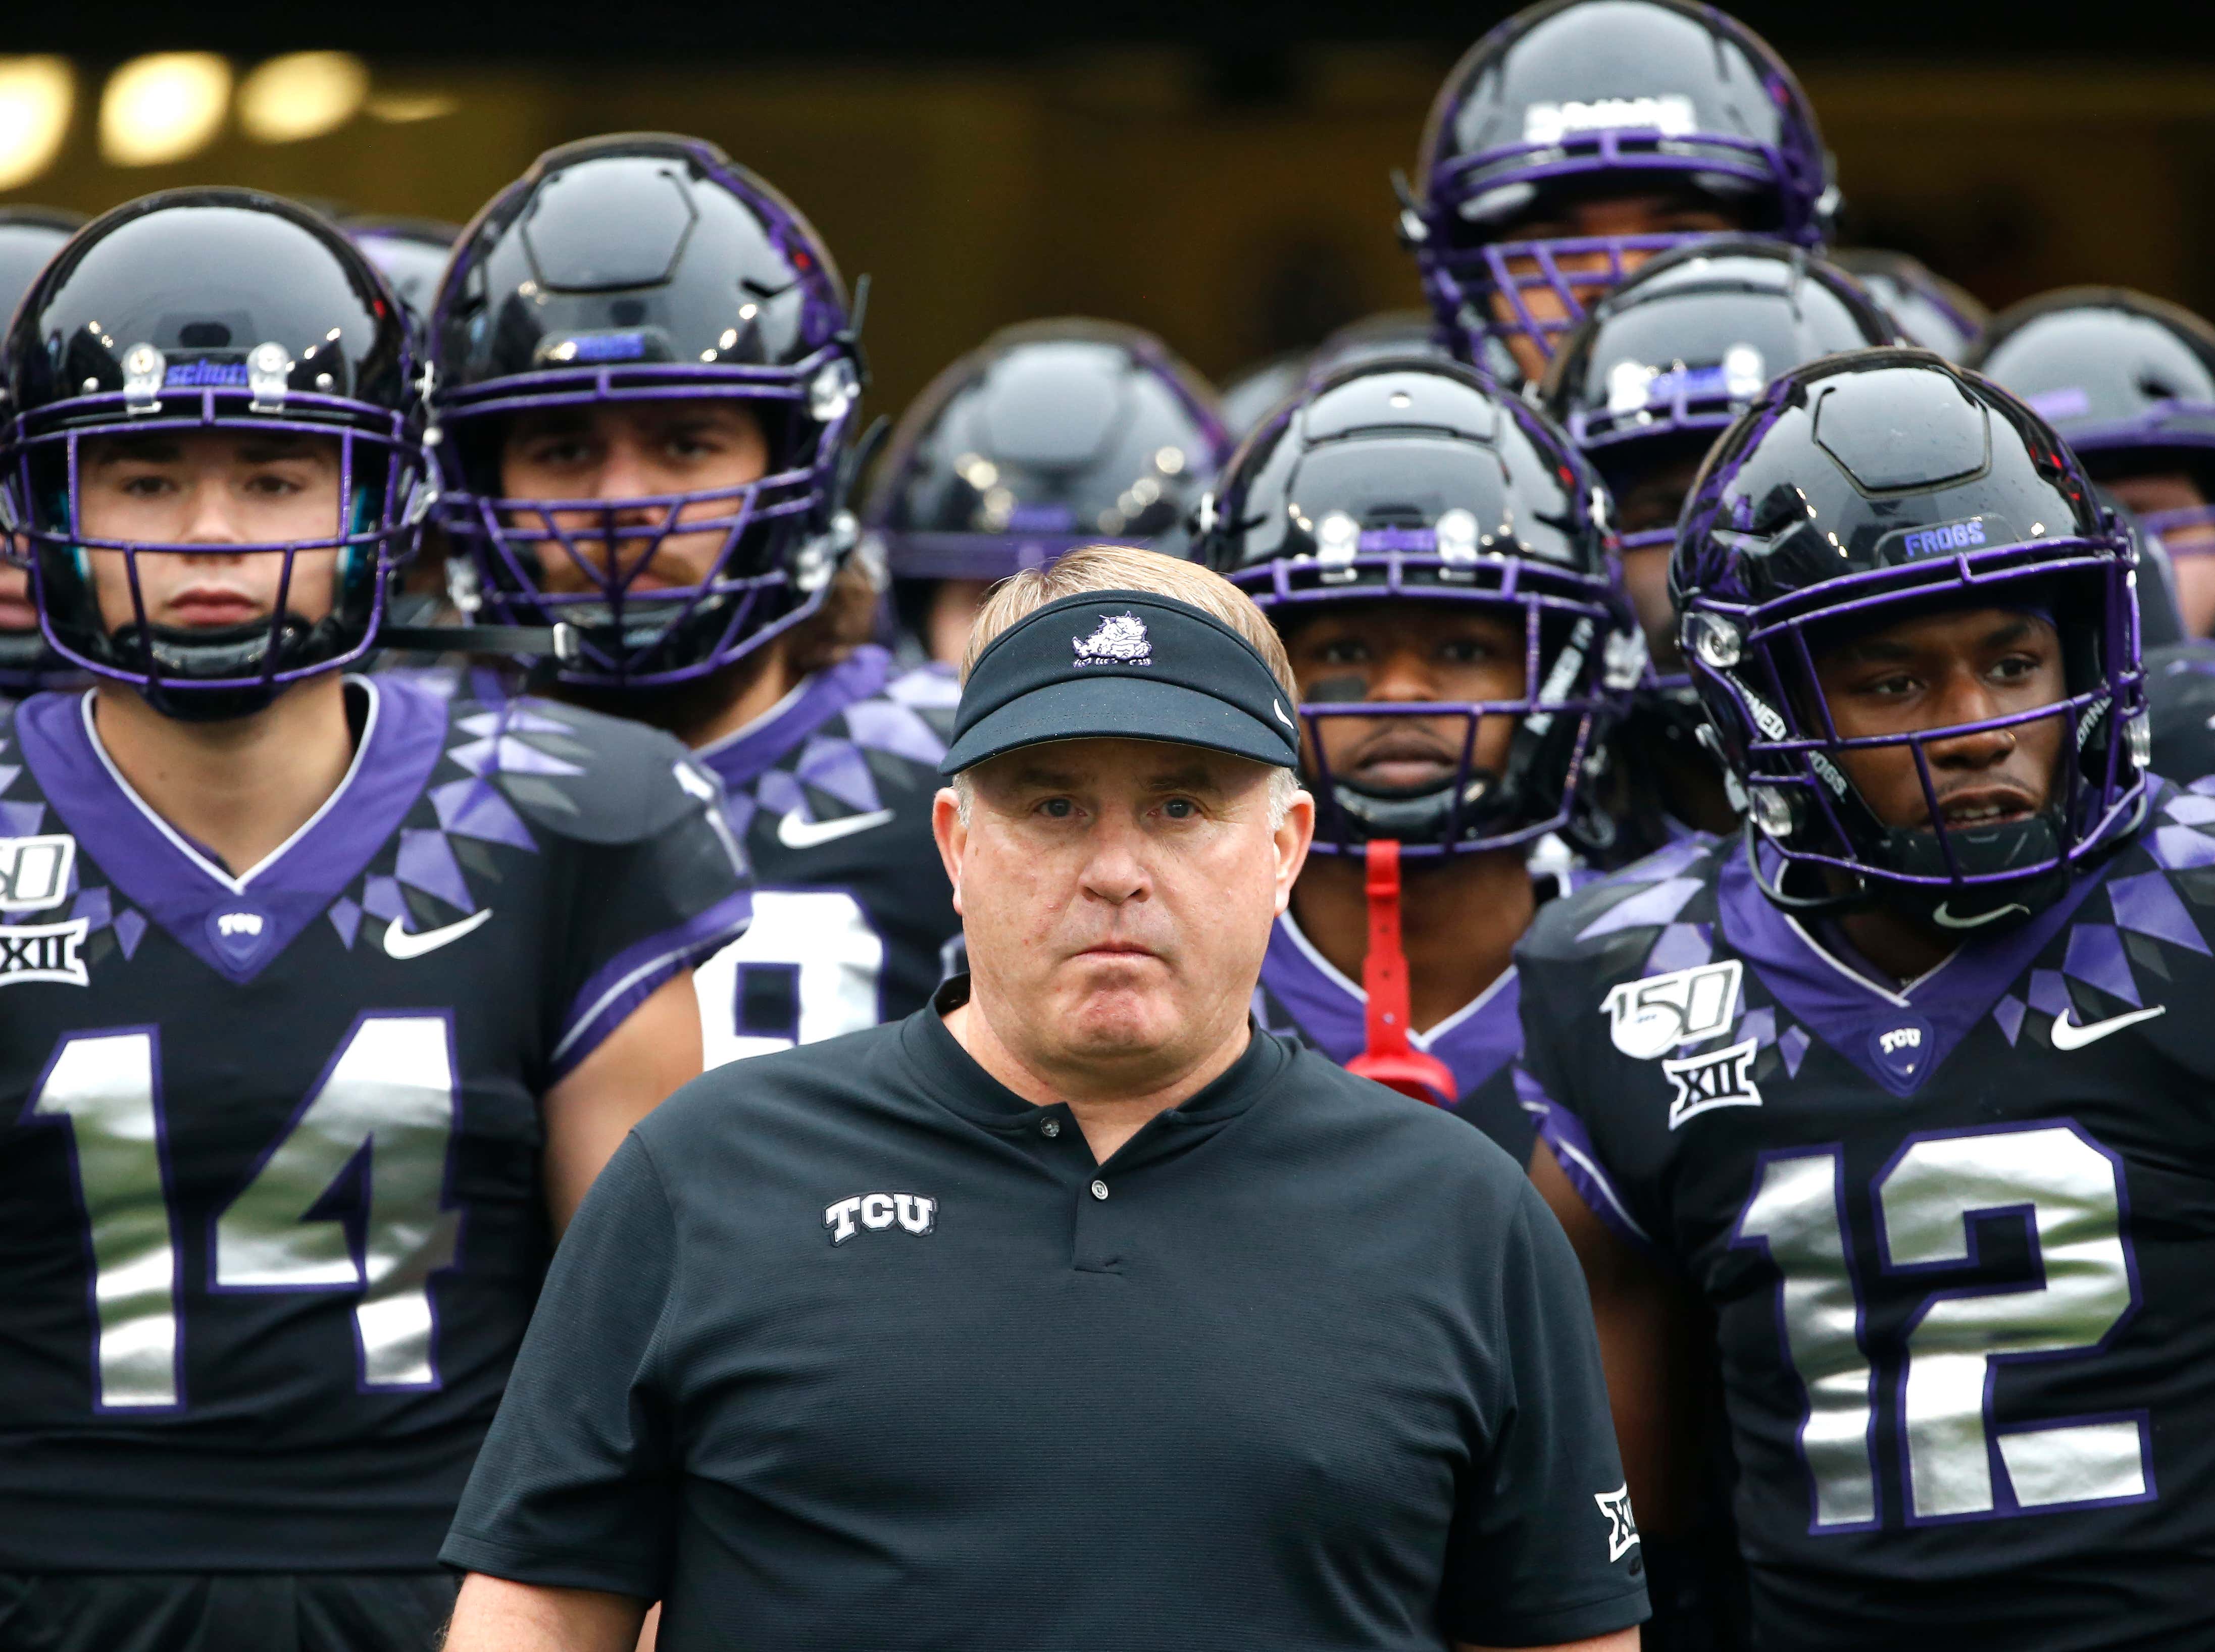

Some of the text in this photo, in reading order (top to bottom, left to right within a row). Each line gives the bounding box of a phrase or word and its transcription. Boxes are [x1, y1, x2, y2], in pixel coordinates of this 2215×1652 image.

[1904, 521, 1986, 557] FROGS
[1599, 959, 1743, 1059] 150
[1879, 1027, 1922, 1056] TCU
[1665, 1043, 1758, 1124] XII
[19, 1007, 471, 1414] 14
[823, 1192, 937, 1245] TCU
[1727, 1116, 2159, 1536] 12
